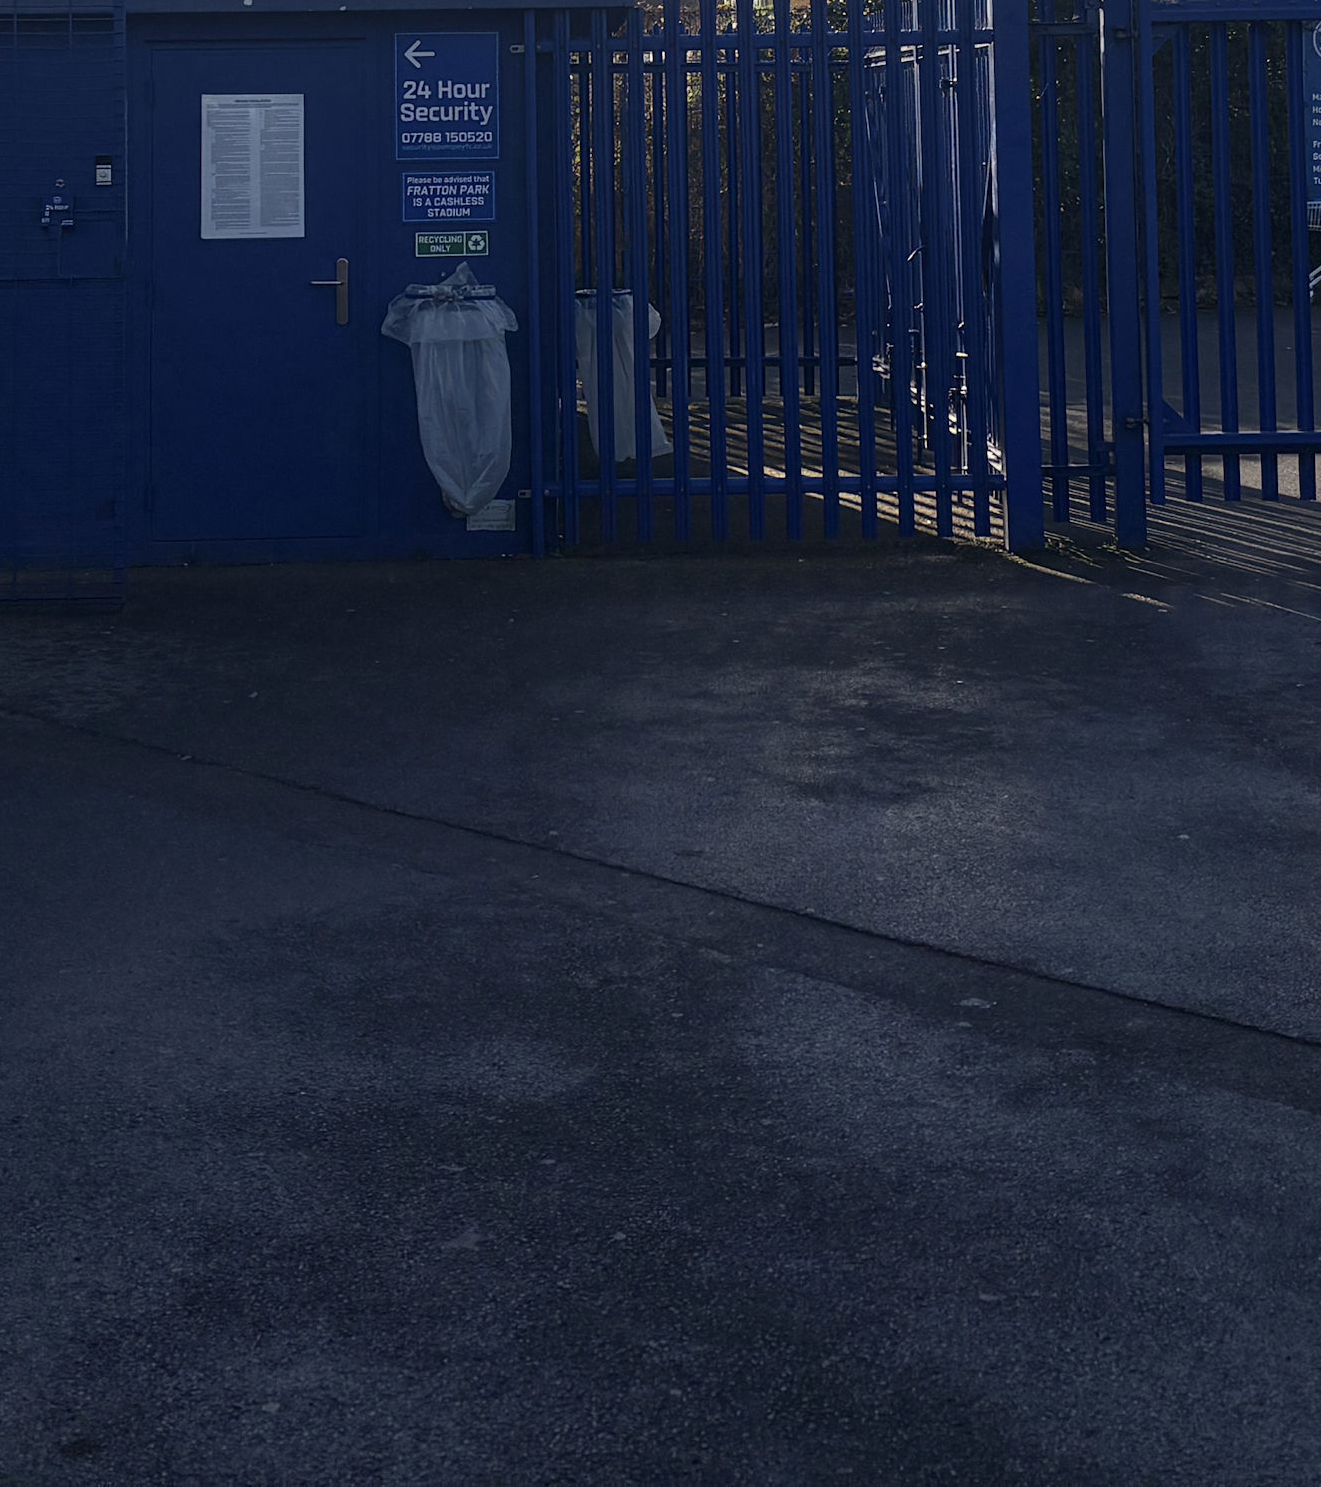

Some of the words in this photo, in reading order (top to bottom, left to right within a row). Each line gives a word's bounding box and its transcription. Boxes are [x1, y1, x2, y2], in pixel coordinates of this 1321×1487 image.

[403, 80, 431, 99] 24
[438, 80, 490, 99] Hour
[400, 101, 493, 126] Security
[401, 132, 442, 144] 07788
[445, 131, 493, 143] 150520
[407, 176, 431, 184] Please
[444, 175, 472, 183] advised
[407, 185, 457, 195] FRATTON
[460, 184, 490, 194] PARK
[413, 198, 422, 206] IS
[425, 198, 432, 206] A
[434, 197, 484, 206] CASHLESS
[427, 208, 470, 217] STADIUM
[418, 235, 463, 244] RECYCLING
[430, 244, 451, 253] ONLY
